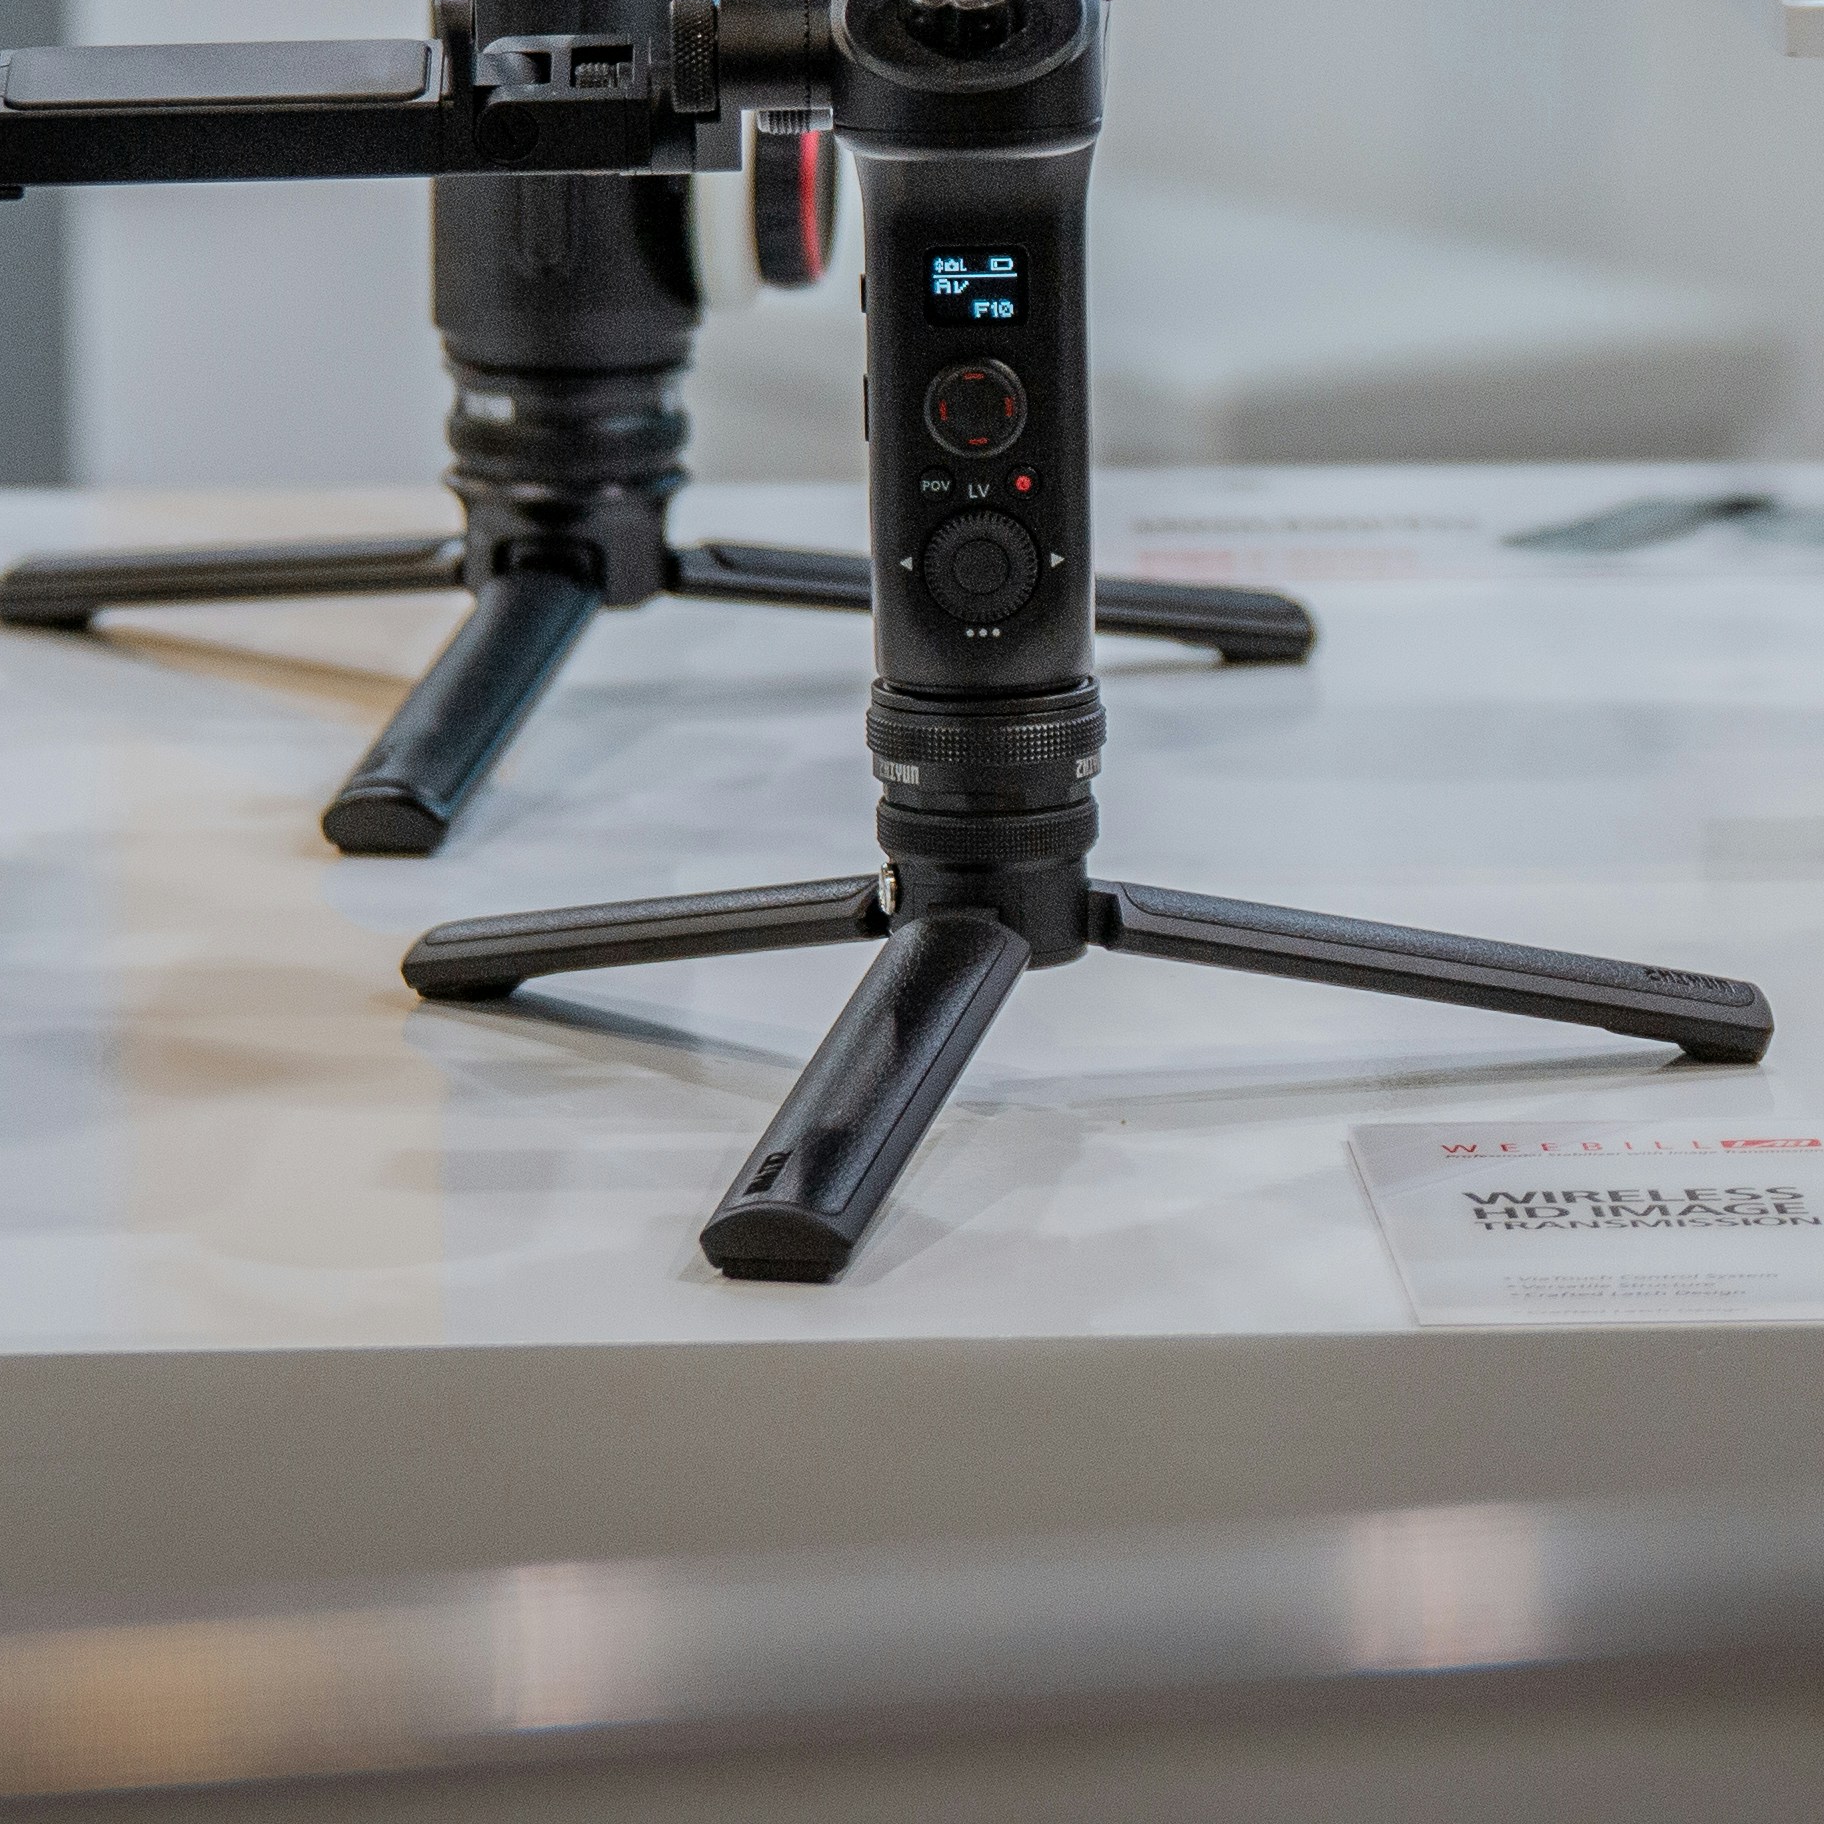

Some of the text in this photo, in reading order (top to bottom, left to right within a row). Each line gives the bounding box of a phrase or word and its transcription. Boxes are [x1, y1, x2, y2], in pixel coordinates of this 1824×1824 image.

[974, 301, 1014, 318] F10
[921, 480, 951, 491] POV
[968, 484, 990, 498] LV
[1442, 1140, 1713, 1154] WEEBILL
[1462, 1186, 1805, 1205] WIRELESS
[1472, 1202, 1809, 1220] HD IMAGE
[1475, 1216, 1824, 1230] TRANSMISSION
